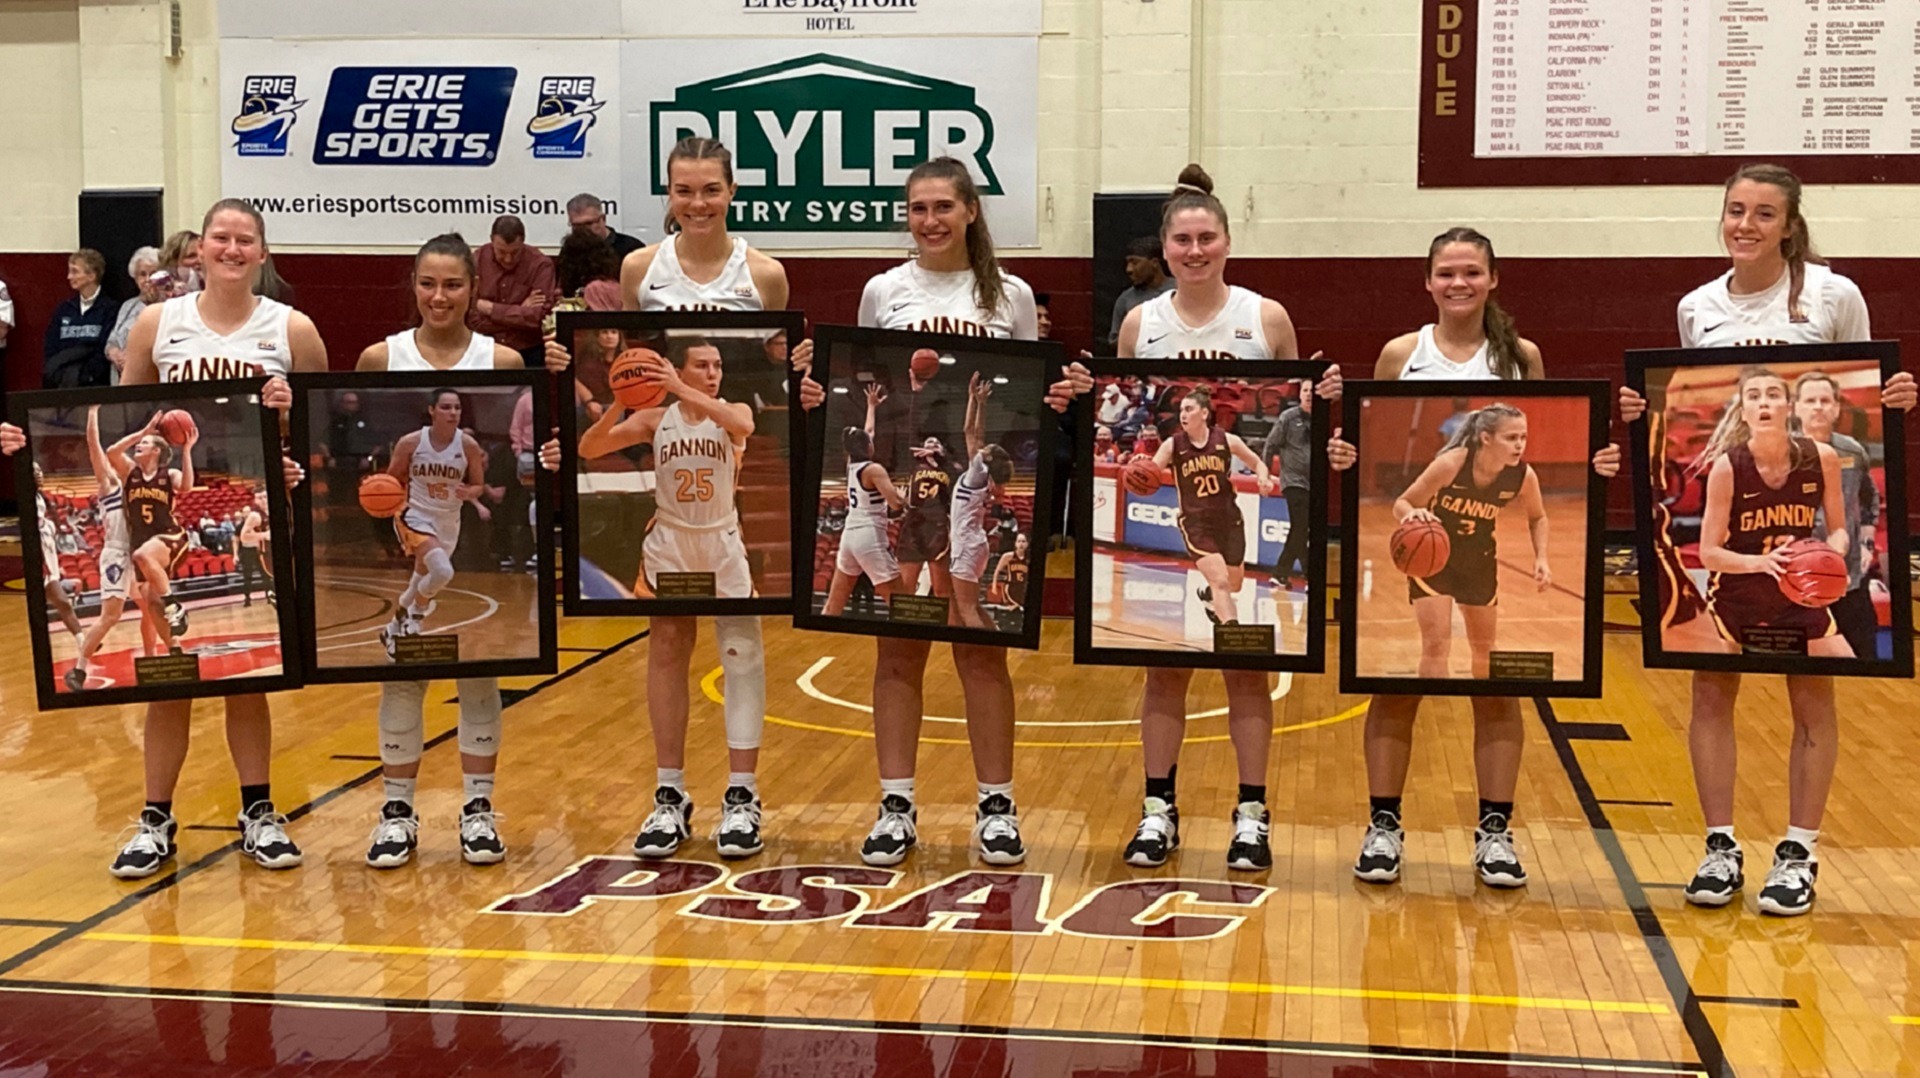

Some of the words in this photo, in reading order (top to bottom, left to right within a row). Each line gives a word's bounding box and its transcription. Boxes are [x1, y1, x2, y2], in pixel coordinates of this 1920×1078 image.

[806, 17, 855, 30] HOTEL
[1435, 0, 1463, 115] DULE
[246, 78, 294, 94] ERIE
[367, 74, 466, 99] ERIE
[542, 79, 592, 95] ERIE
[353, 103, 463, 130] GETS
[243, 193, 618, 217] ww.eriesportscommission.m
[731, 201, 791, 222] TRY
[806, 201, 908, 222] SYSTE
[660, 437, 727, 466] GANNON
[412, 463, 462, 480] GANNON
[1181, 455, 1226, 478] GANNON
[128, 486, 169, 505] GANNON
[427, 482, 450, 500] 15
[674, 468, 714, 502] 25
[918, 482, 940, 499] 54
[1193, 473, 1220, 498] 20
[141, 503, 154, 525] 5
[1740, 504, 1816, 532] GANNON
[1457, 519, 1476, 536] 3
[478, 855, 1277, 941] PSAC
